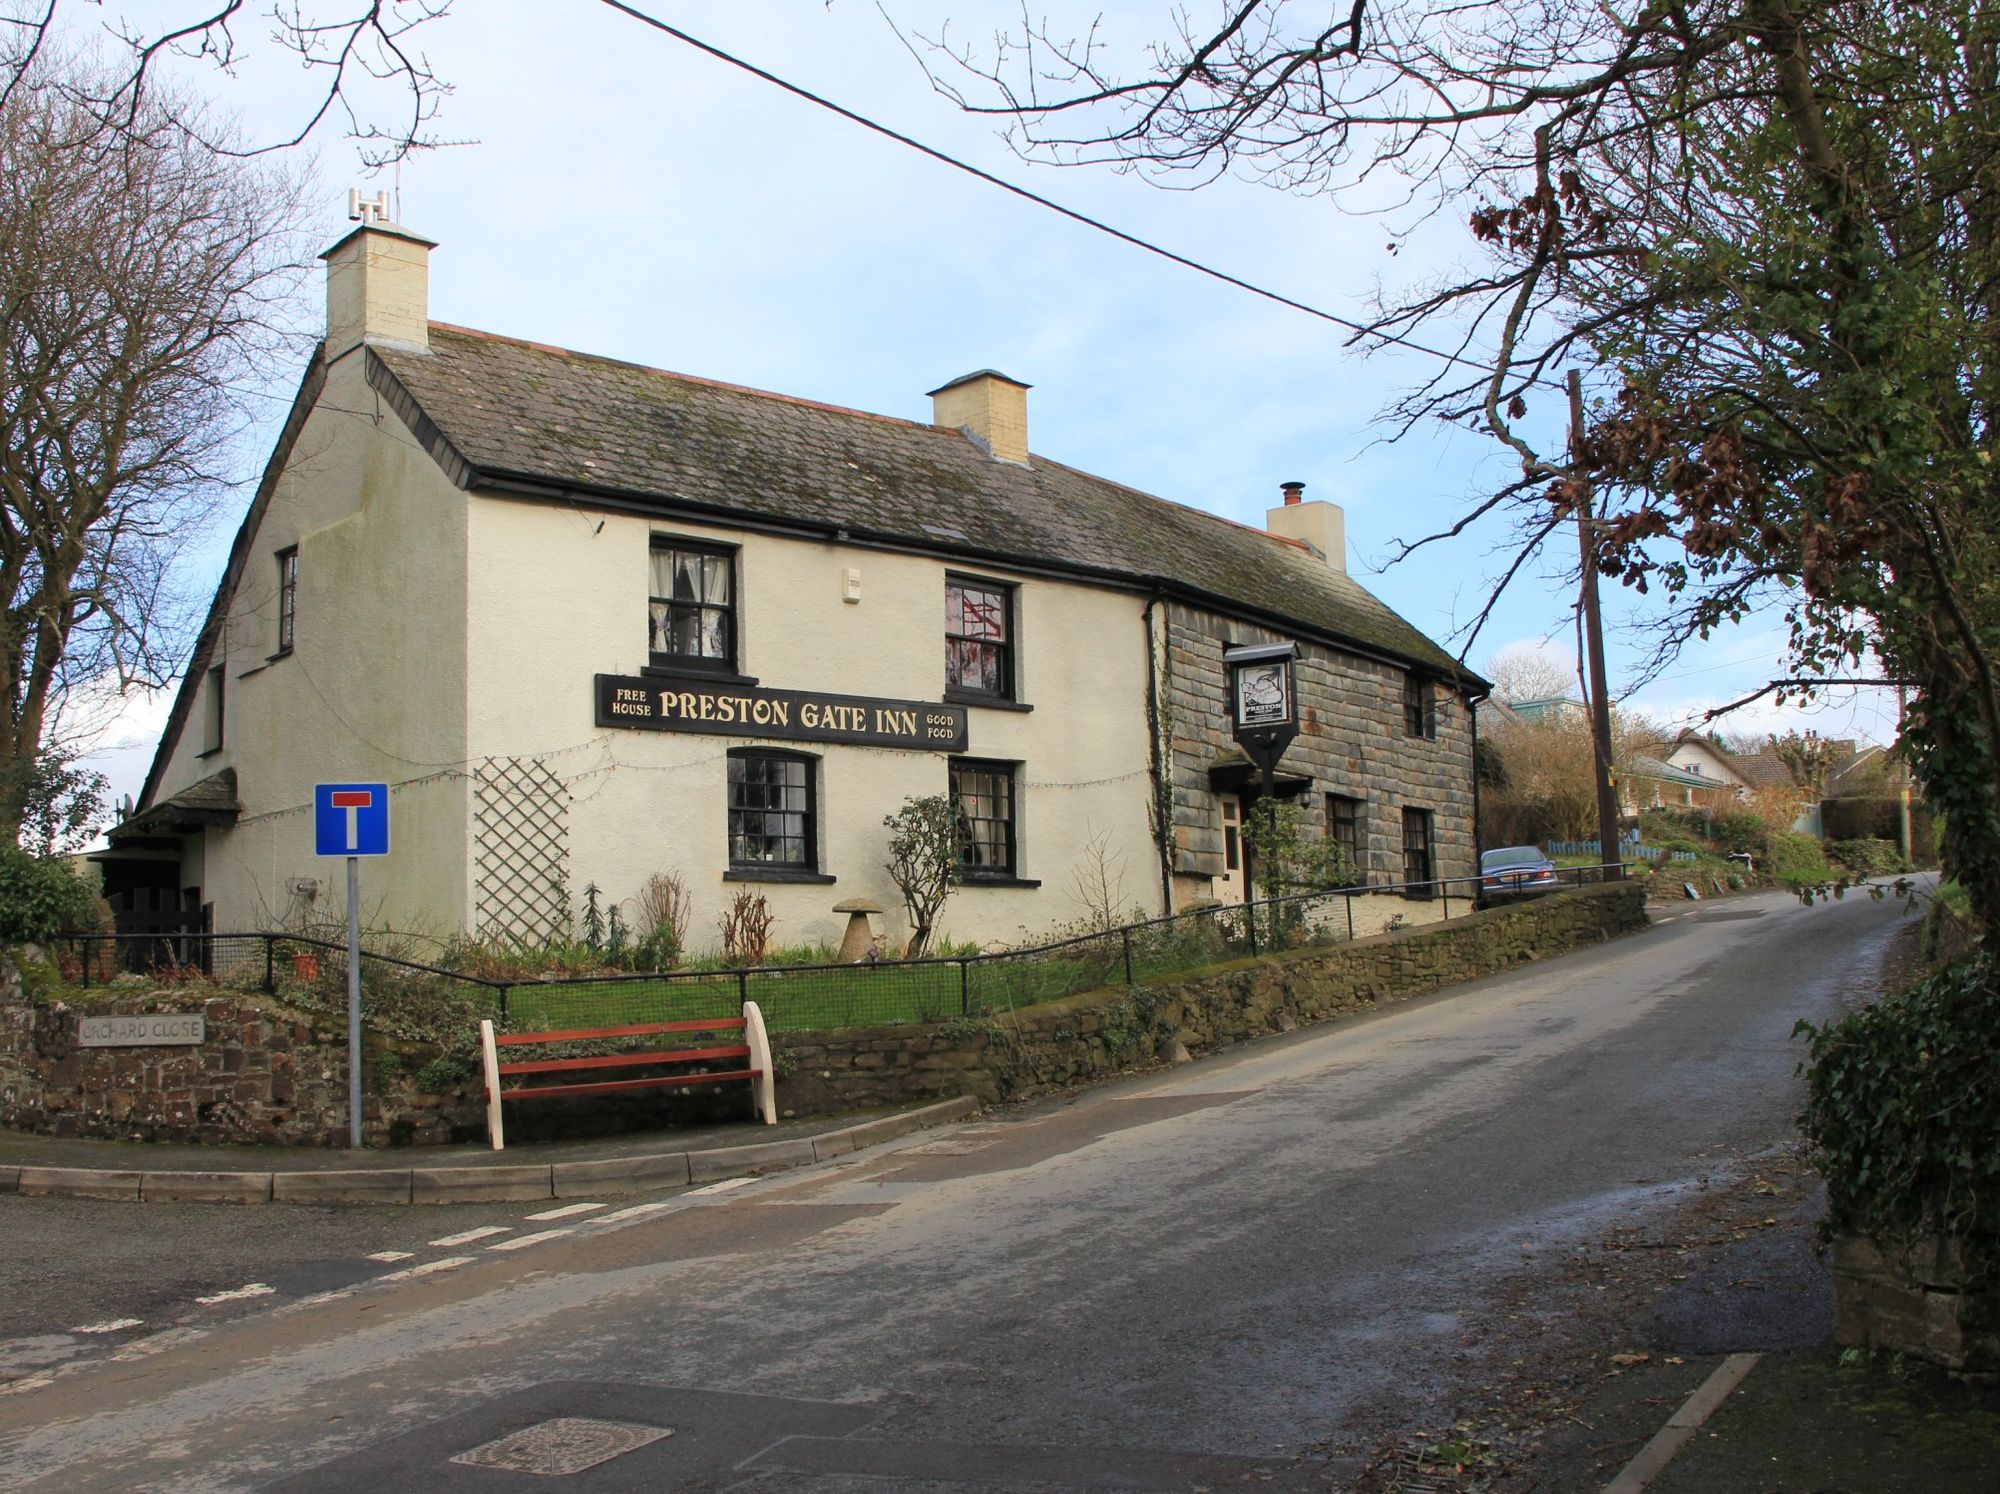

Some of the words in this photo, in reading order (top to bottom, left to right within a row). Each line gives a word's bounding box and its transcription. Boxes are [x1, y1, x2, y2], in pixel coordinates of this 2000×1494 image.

[617, 688, 647, 702] FREE
[612, 702, 651, 717] HOUSE
[658, 691, 789, 727] PRESTON
[800, 702, 867, 732] GATE
[875, 709, 917, 737] INN
[926, 714, 954, 727] GOOD
[927, 727, 954, 739] FOOD
[83, 1021, 147, 1040] ORCHARD
[152, 1021, 199, 1038] CLOSE
